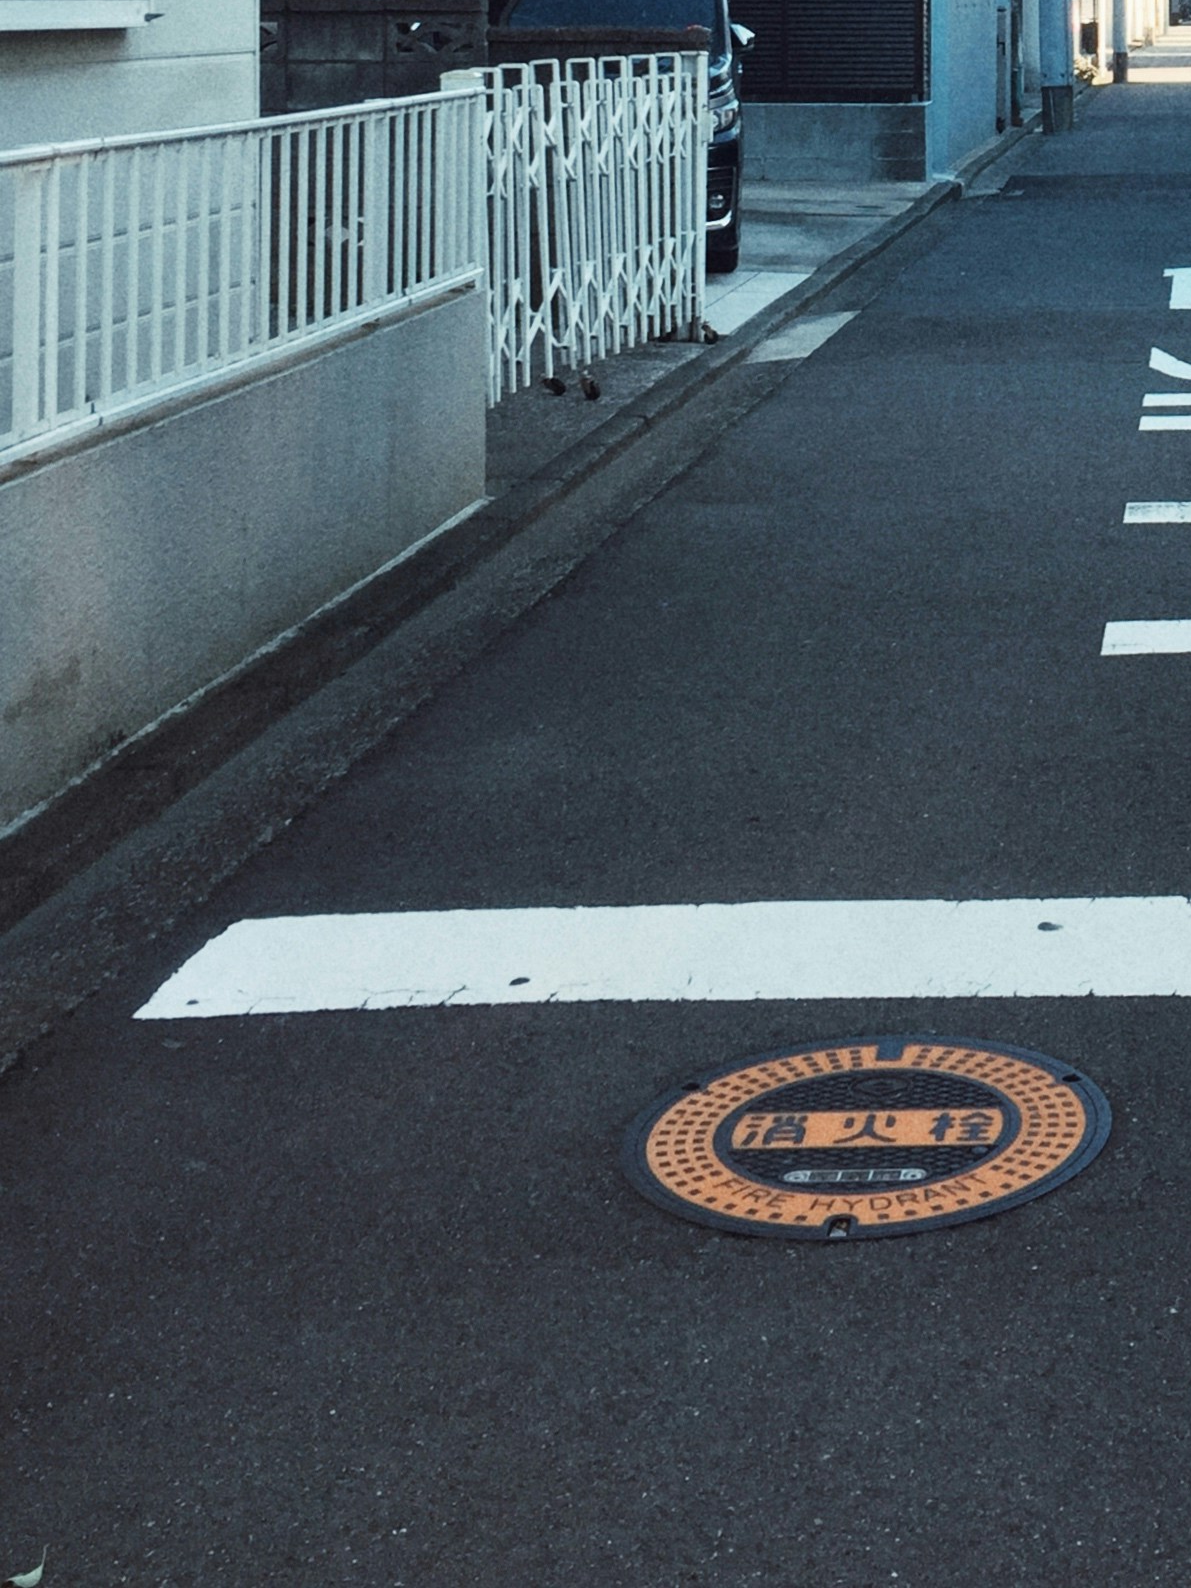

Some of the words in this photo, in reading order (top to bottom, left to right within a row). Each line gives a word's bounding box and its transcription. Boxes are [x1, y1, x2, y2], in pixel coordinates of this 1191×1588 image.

[741, 1112, 994, 1146] 消火栓
[713, 1177, 795, 1209] FIRE
[809, 1173, 987, 1212] HYDRANT
